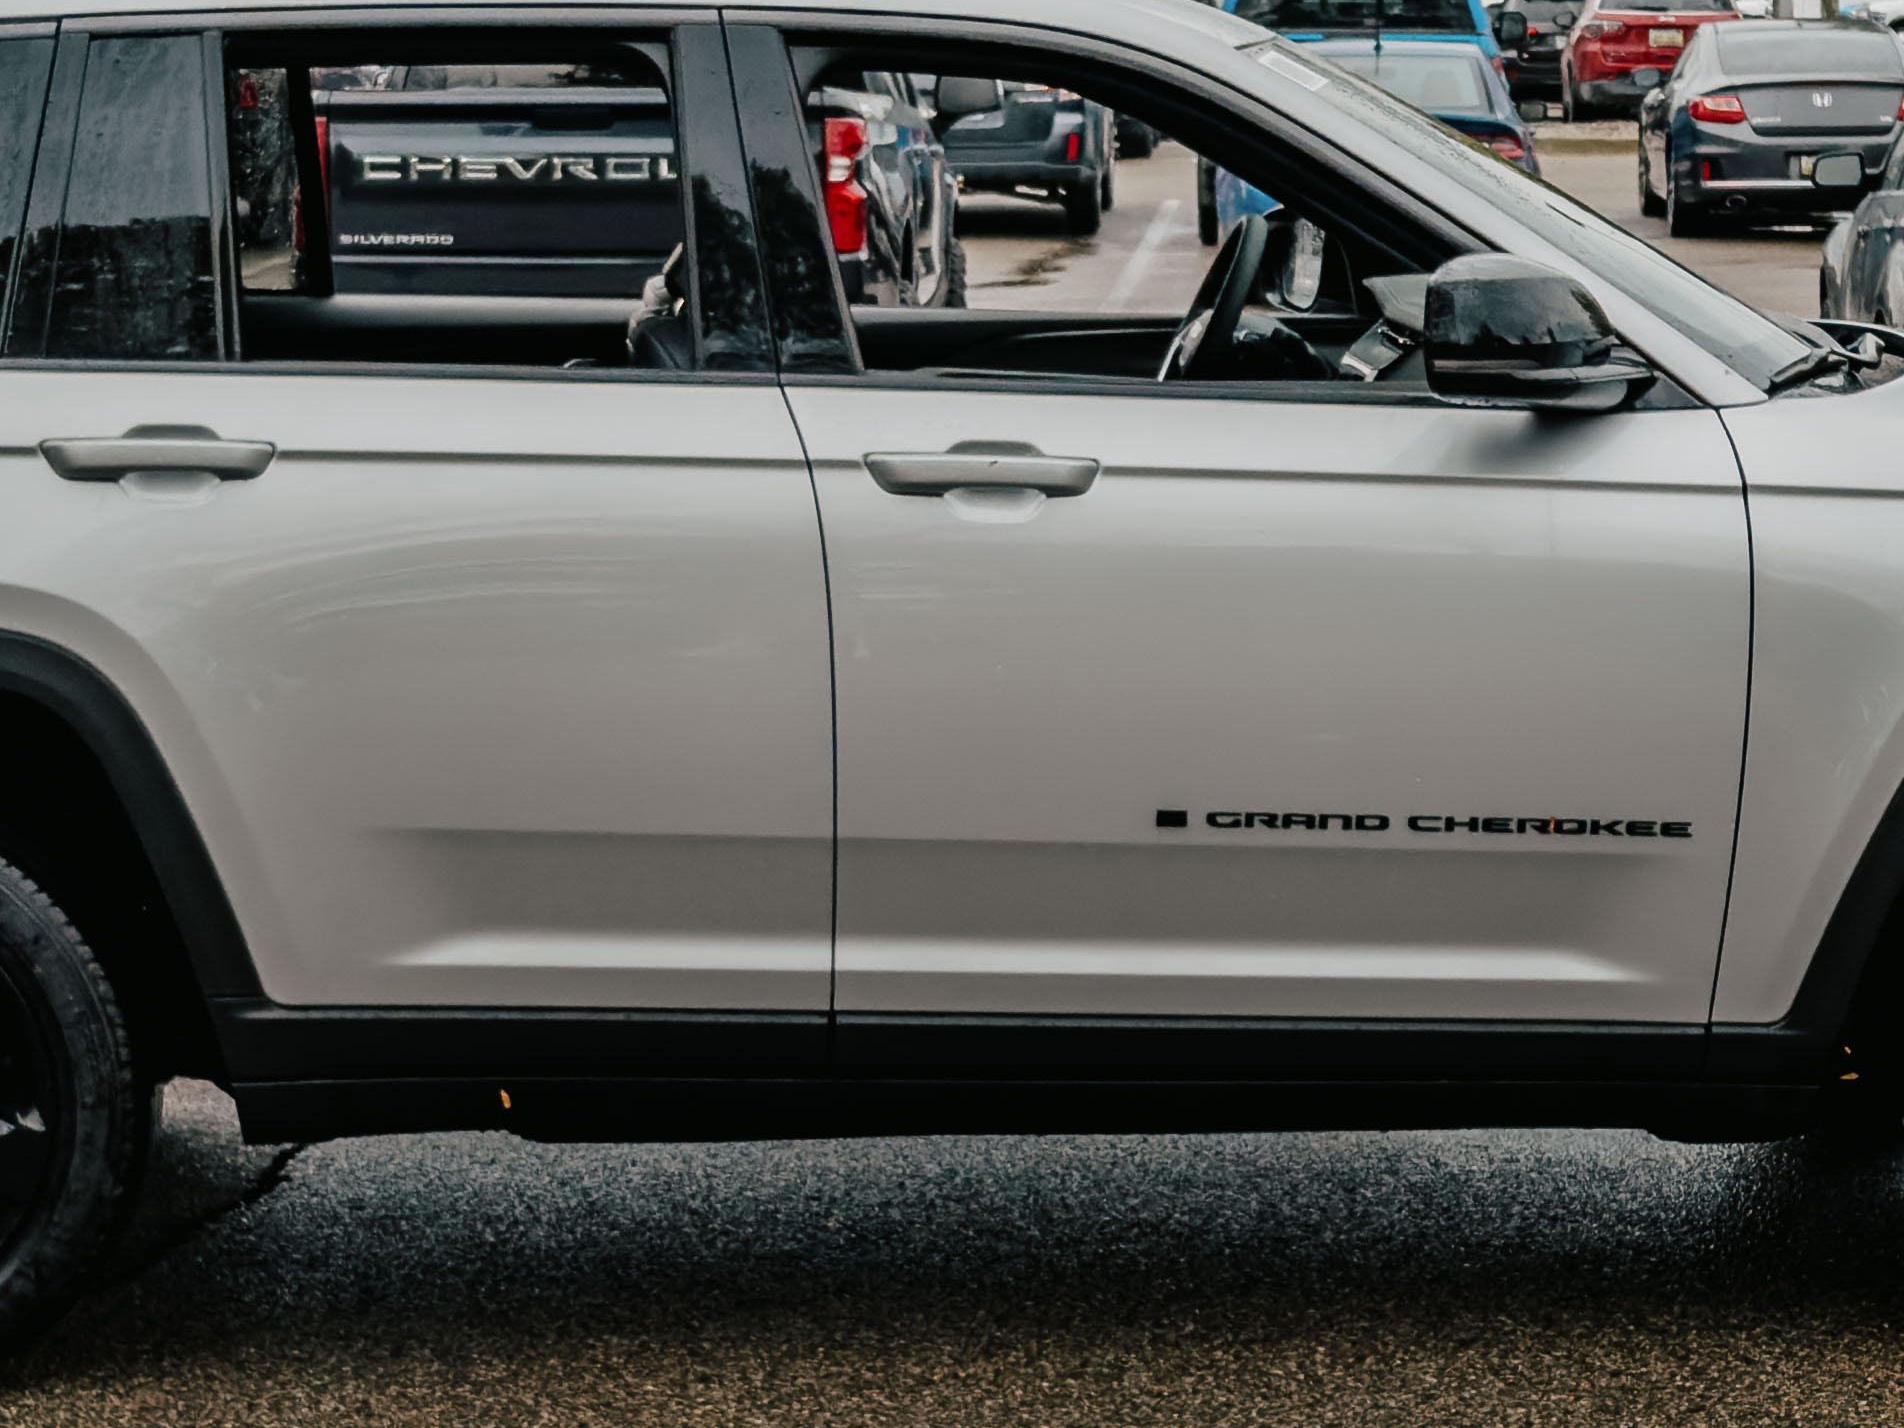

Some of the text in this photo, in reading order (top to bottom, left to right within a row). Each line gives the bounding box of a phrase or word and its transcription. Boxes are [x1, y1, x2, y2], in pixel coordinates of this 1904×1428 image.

[339, 234, 454, 246] SILVERADO
[1205, 810, 1693, 839] GRAND CHEROKEE
